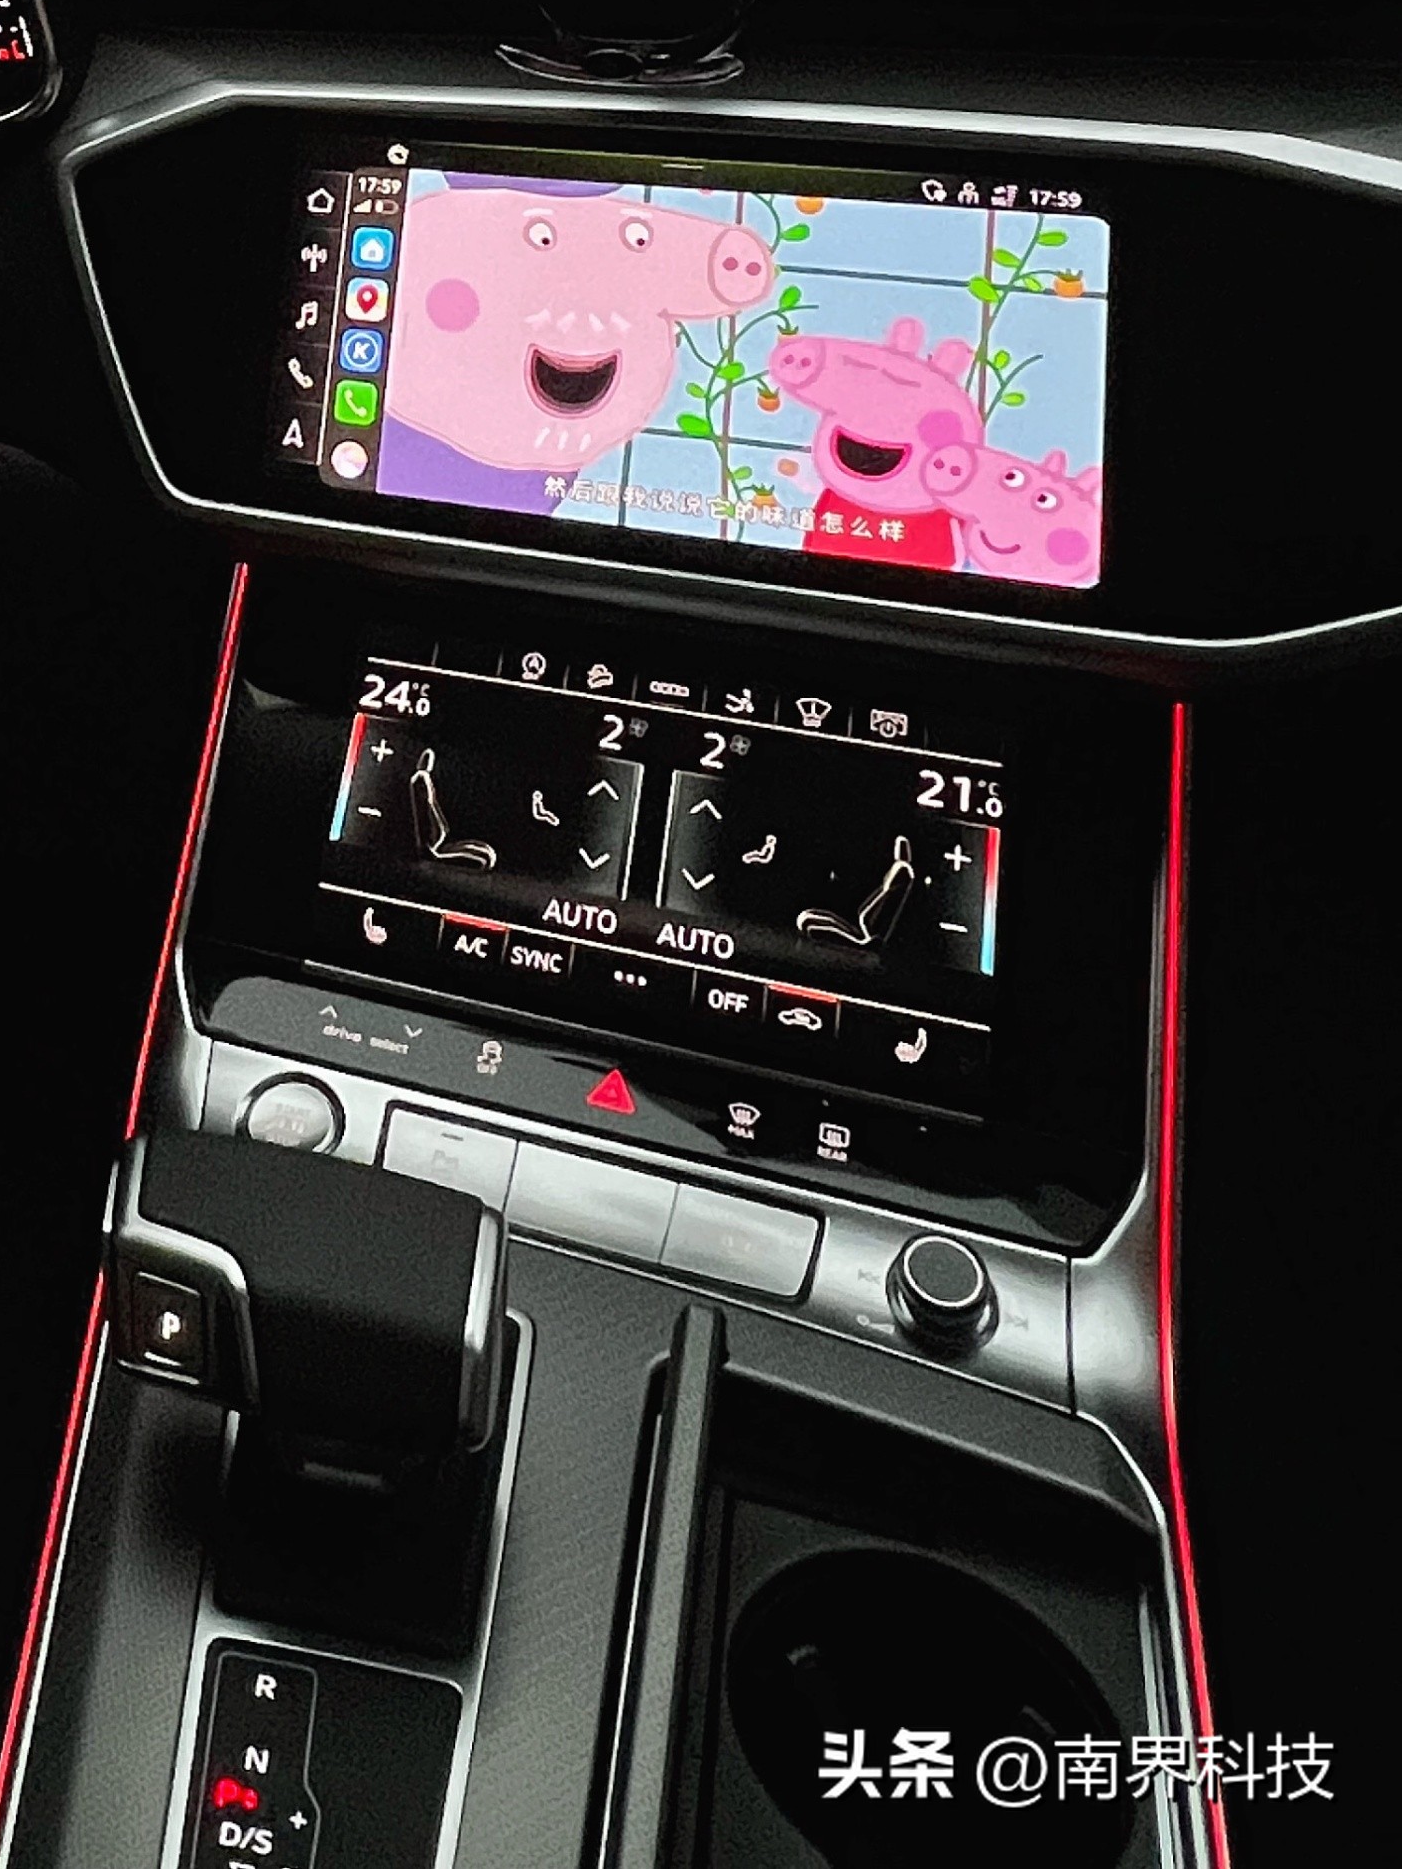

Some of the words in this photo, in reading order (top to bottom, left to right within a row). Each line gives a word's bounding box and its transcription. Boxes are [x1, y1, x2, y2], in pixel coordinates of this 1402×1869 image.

[358, 176, 402, 194] 17:59
[1029, 188, 1082, 209] 17:59
[544, 475, 907, 544] 然后跟我说说它的味道怎么样
[599, 714, 625, 751] 2
[700, 732, 726, 769] 2
[542, 899, 618, 934] AUTO
[454, 934, 489, 958] A/C
[656, 923, 735, 959] AUTO
[510, 946, 563, 974] SYNC
[707, 988, 750, 1013] OFF
[162, 1311, 181, 1340] P
[254, 1673, 277, 1700] R
[244, 1745, 269, 1774] N
[218, 1821, 273, 1855] D/S
